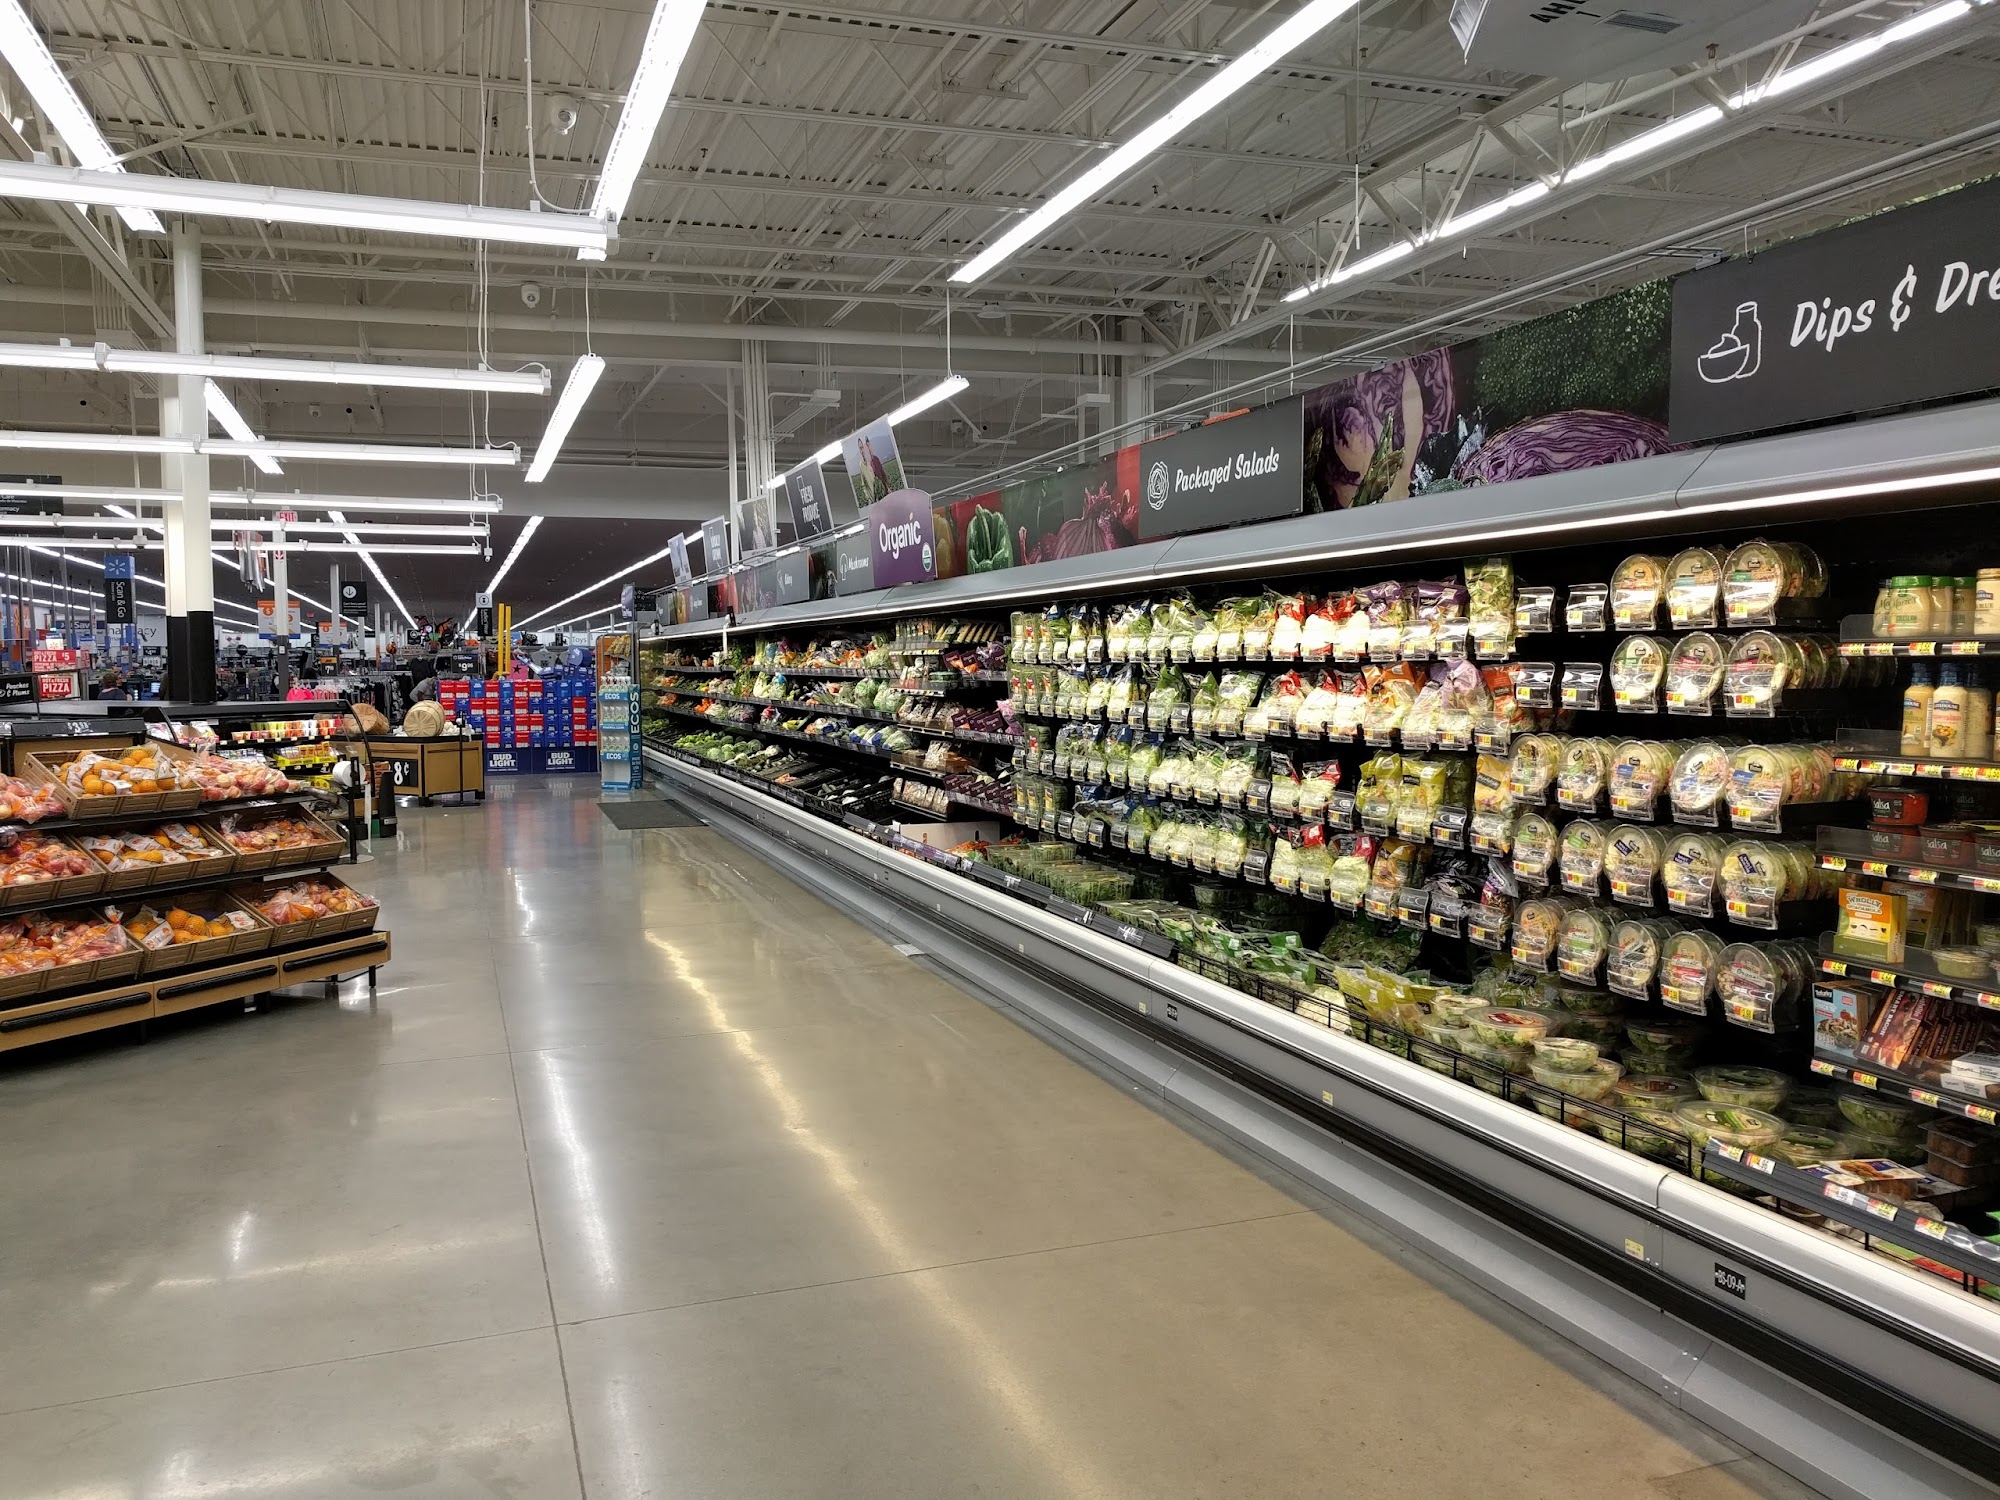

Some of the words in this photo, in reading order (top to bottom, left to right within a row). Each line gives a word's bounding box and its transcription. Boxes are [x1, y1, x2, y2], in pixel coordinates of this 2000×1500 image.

[1790, 297, 1876, 352] Dips
[1889, 264, 1917, 332] &
[1935, 261, 2000, 313] Dre
[1174, 457, 1232, 493] Packaged
[1234, 446, 1280, 480] Salads
[279, 512, 295, 522] EXIT
[879, 511, 922, 560] Organic
[115, 580, 125, 599] Scan
[118, 607, 127, 618] Go
[572, 636, 587, 644] Toys
[62, 652, 70, 661] $5
[43, 683, 70, 693] PIZZA
[604, 692, 620, 700] ECOS
[630, 691, 640, 734] ECOS
[492, 752, 513, 760] BUD
[551, 751, 571, 759] BUD
[606, 752, 622, 760] ECOS
[489, 759, 516, 767] LIGHT
[548, 758, 575, 766] LIGHT
[1873, 798, 1891, 810] salsa
[1872, 832, 1889, 843] salsa
[1926, 838, 1948, 850] salsa
[1847, 896, 1882, 908] WHOLLY
[1879, 1014, 1894, 1038] BACON
